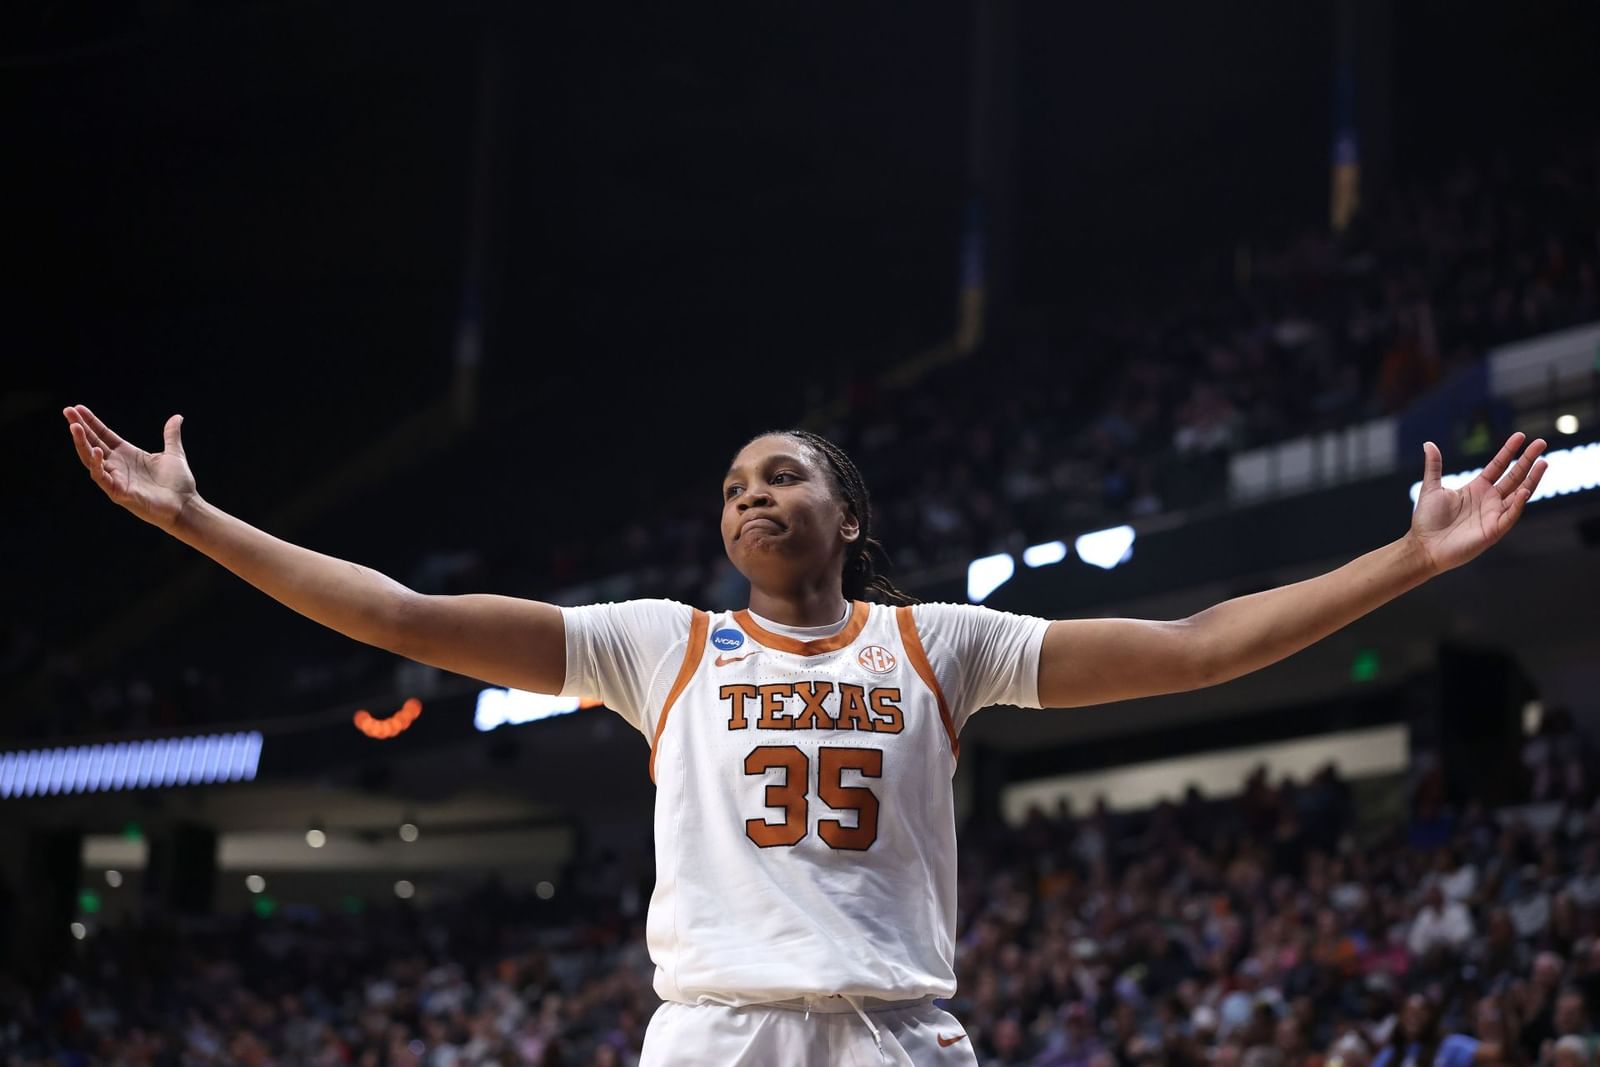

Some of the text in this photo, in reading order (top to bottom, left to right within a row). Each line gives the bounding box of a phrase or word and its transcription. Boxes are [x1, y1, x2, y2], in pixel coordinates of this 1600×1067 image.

[714, 637, 741, 647] NCAA
[859, 647, 896, 671] SEC
[719, 681, 905, 735] TEXAS
[744, 745, 883, 851] 35
